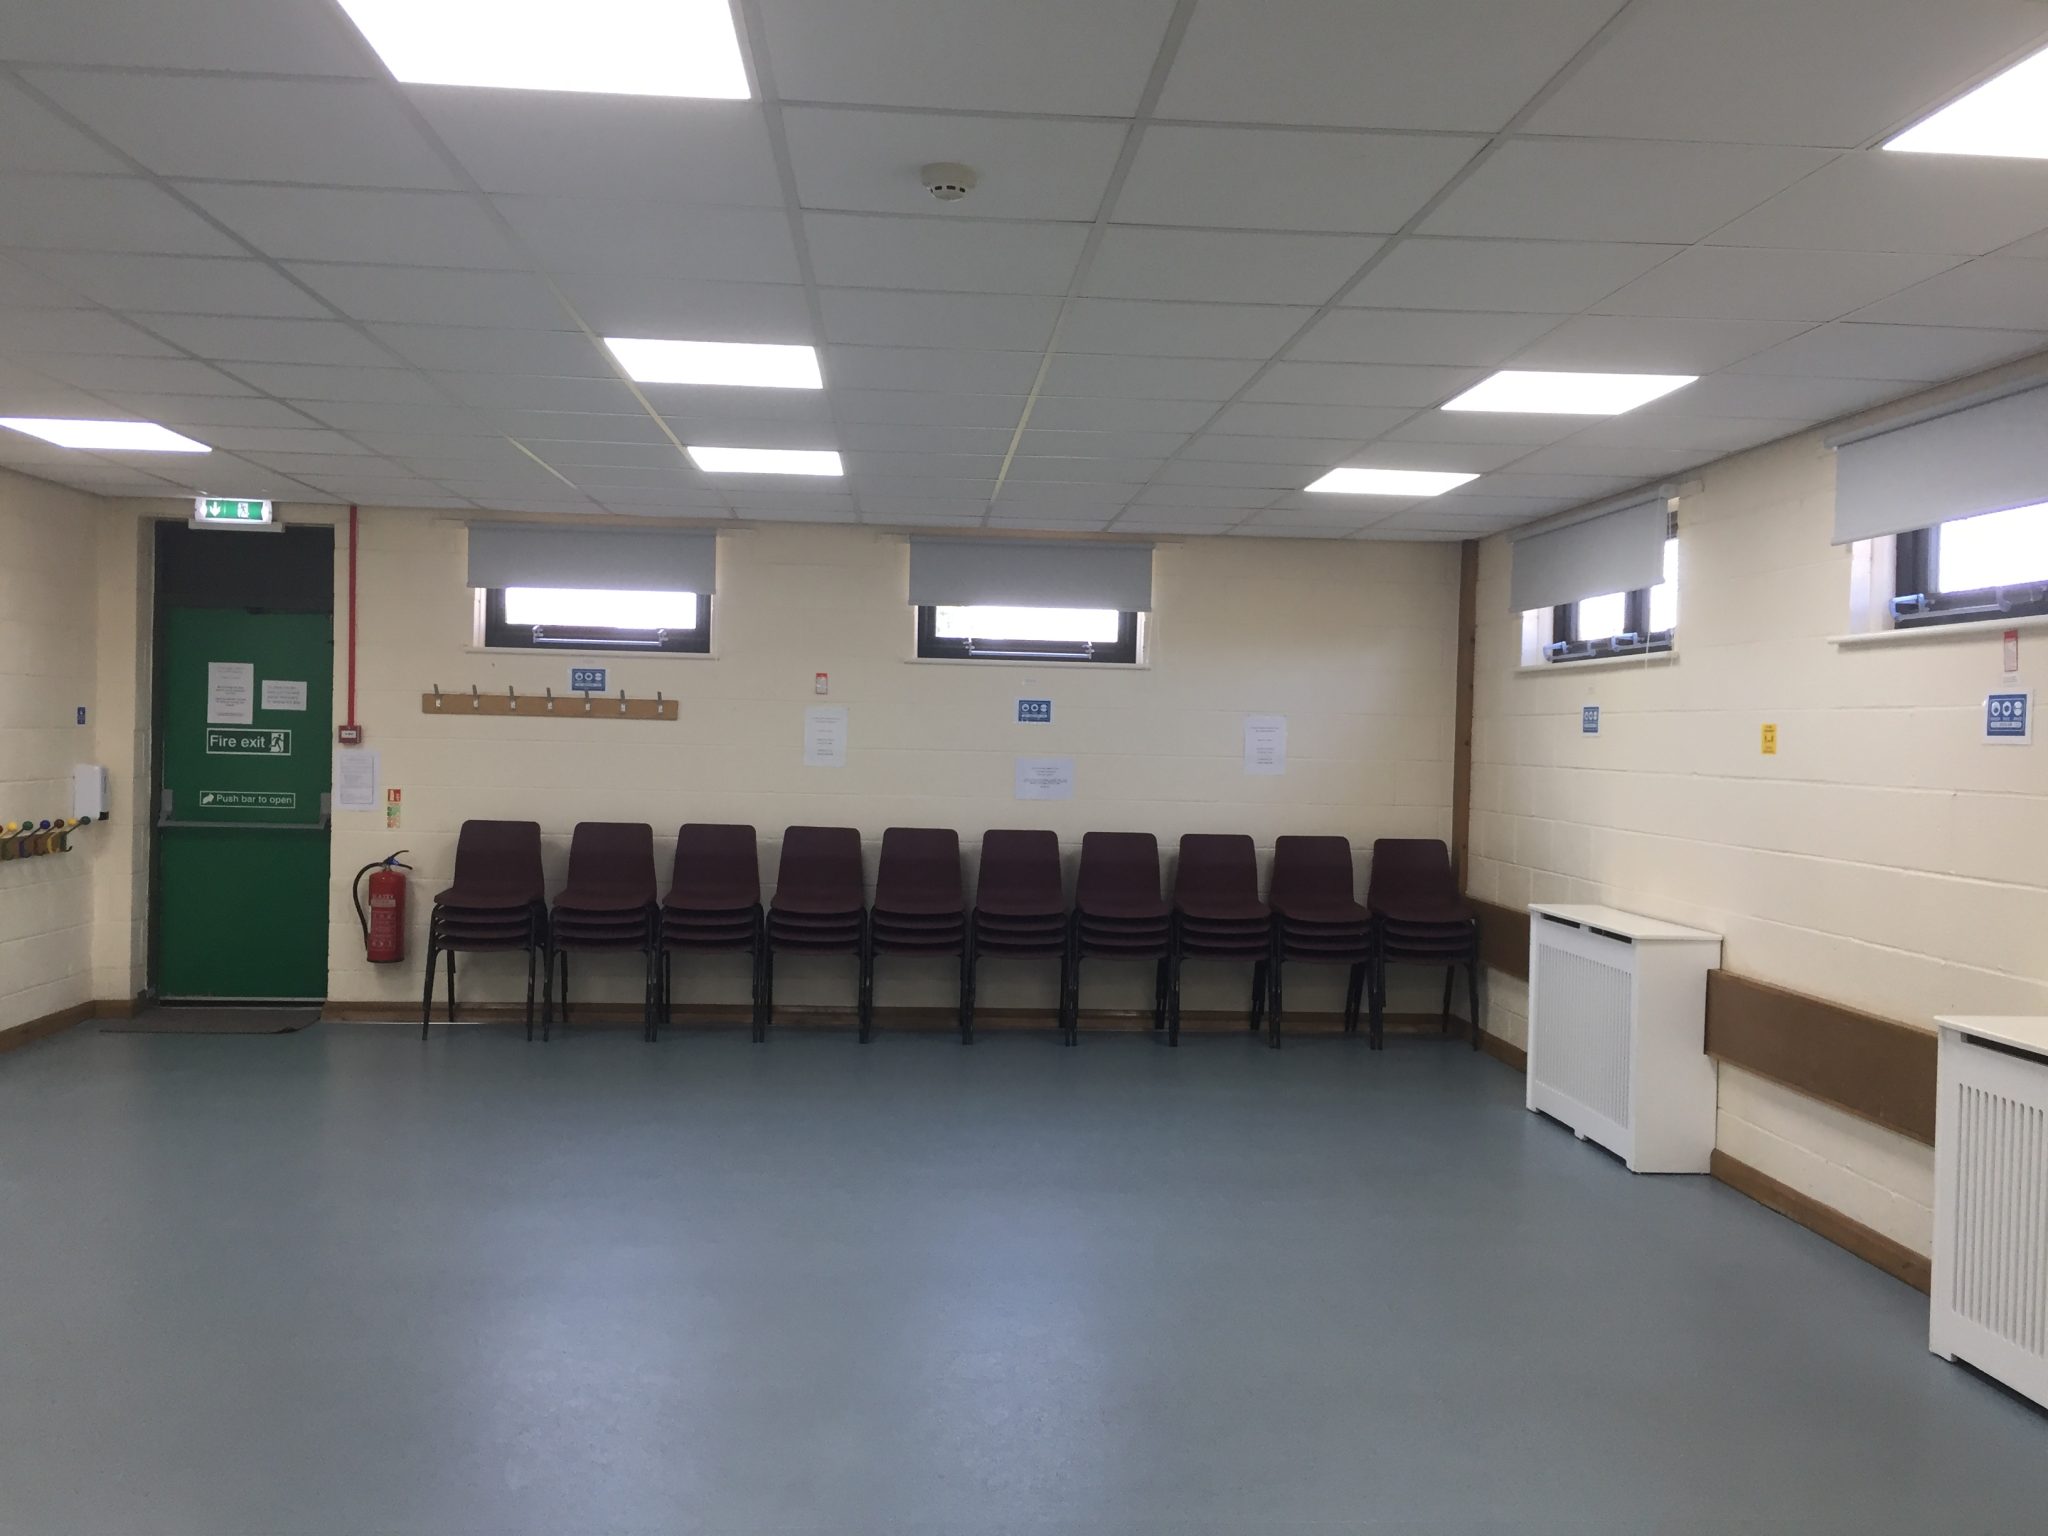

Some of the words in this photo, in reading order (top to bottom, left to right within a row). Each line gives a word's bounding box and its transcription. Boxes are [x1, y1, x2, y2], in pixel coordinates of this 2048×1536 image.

[210, 735, 237, 748] Fire
[241, 736, 266, 748] exit
[216, 794, 239, 803] Push
[241, 795, 256, 803] bar
[258, 796, 267, 804] to
[269, 797, 292, 805] open
